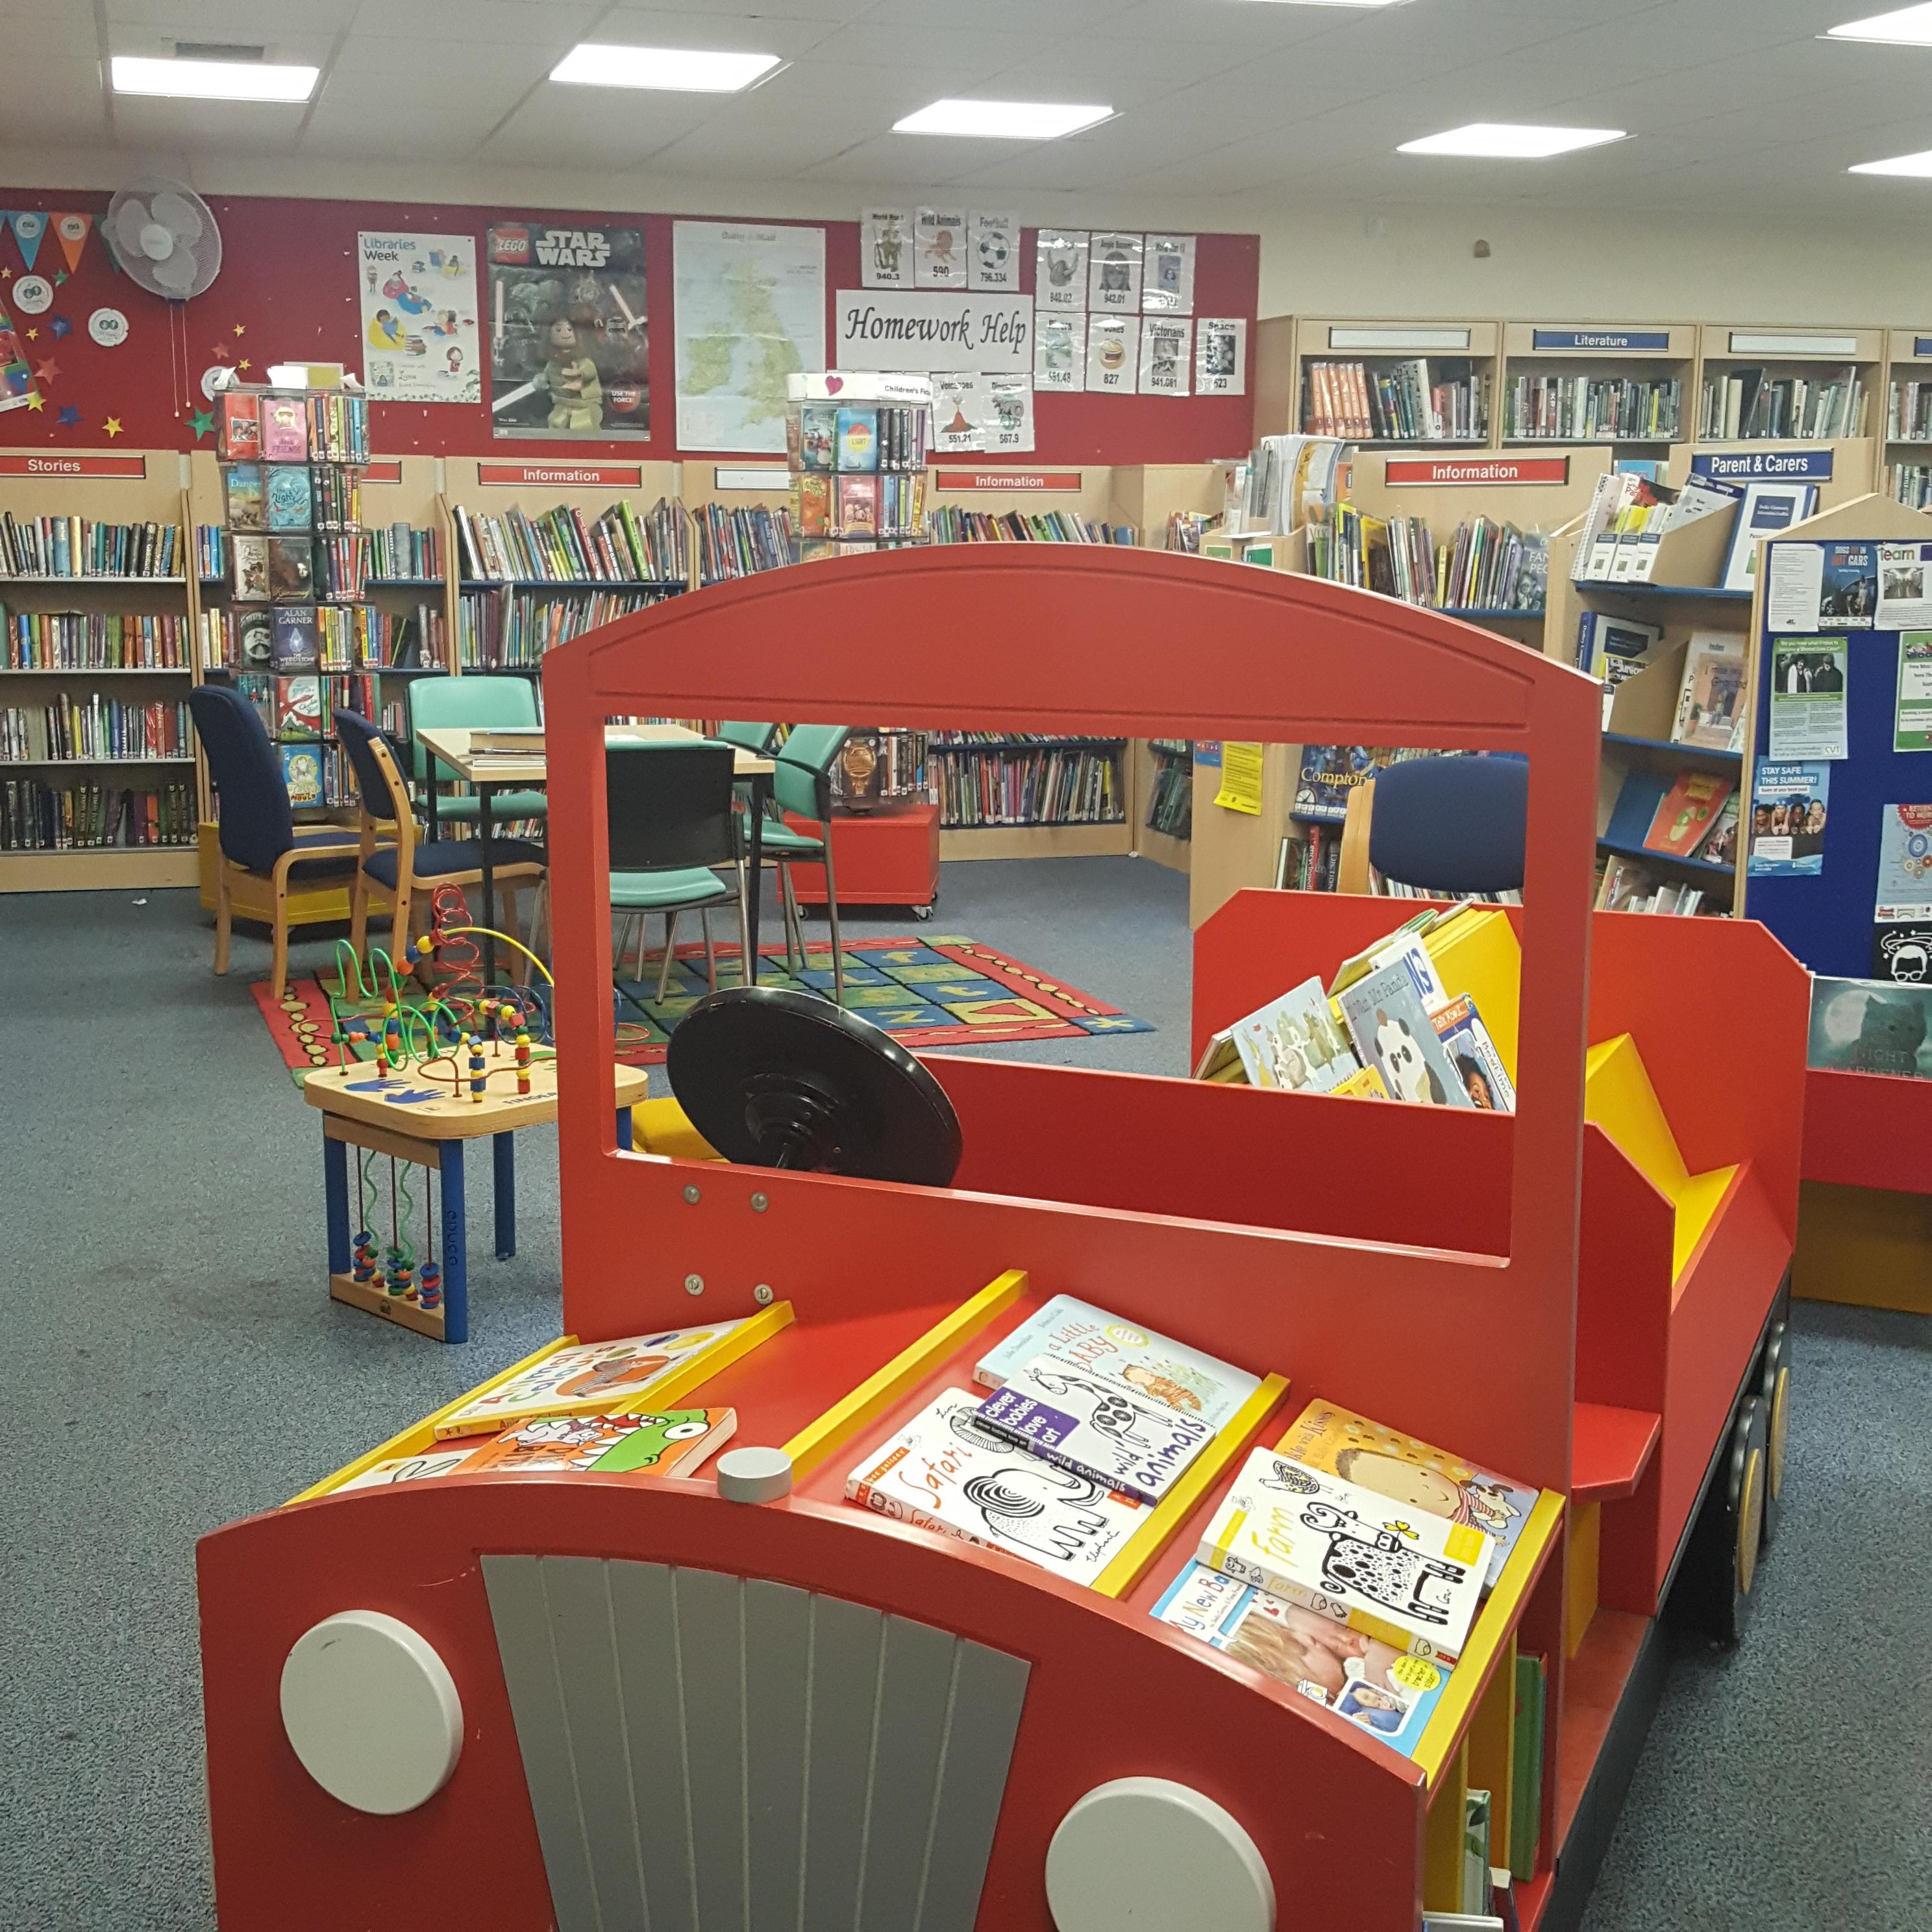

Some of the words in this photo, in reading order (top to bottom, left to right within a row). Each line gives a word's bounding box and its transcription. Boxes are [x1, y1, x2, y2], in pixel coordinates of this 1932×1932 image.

[921, 214, 935, 225] Wild
[936, 215, 961, 226] Animals
[980, 217, 1009, 228] Football
[364, 238, 416, 250] Libraries
[497, 239, 527, 253] LEGO
[536, 230, 610, 251] STAR
[364, 251, 399, 261] Week
[536, 247, 610, 267] WARS
[933, 266, 949, 277] 590
[980, 272, 1007, 282] 796.334
[1104, 294, 1125, 304] 942.01
[845, 306, 974, 350] Homework
[980, 310, 1026, 354] Help
[1149, 324, 1185, 338] Victorians
[1208, 322, 1235, 330] Space
[1574, 334, 1628, 346] Literature
[1104, 374, 1119, 384] 827
[884, 386, 919, 395] Children's
[999, 434, 1019, 443] 567.9
[27, 459, 81, 472] Stories
[1711, 456, 1751, 473] Parent
[1755, 456, 1763, 471] &
[1765, 455, 1808, 472] Carers
[523, 469, 600, 482] Information
[1433, 464, 1518, 479] Information
[976, 476, 1044, 487] Information
[1848, 555, 1868, 566] CARS
[1762, 767, 1780, 775] STAY
[1779, 776, 1817, 784] SUMMER!
[1380, 974, 1409, 998] Panda
[1052, 1322, 1100, 1344] Little
[478, 1352, 583, 1404] Animal
[986, 1393, 1017, 1418] clever
[1000, 1399, 1039, 1427] babies
[1022, 1415, 1047, 1436] love
[1307, 1411, 1335, 1438] Kisses
[1042, 1426, 1061, 1444] art
[1113, 1441, 1143, 1476] wild
[1135, 1418, 1207, 1488] animals
[898, 1443, 973, 1510] Safari
[1046, 1452, 1072, 1469] wild
[1076, 1465, 1126, 1492] animals
[1182, 1590, 1215, 1618] New
